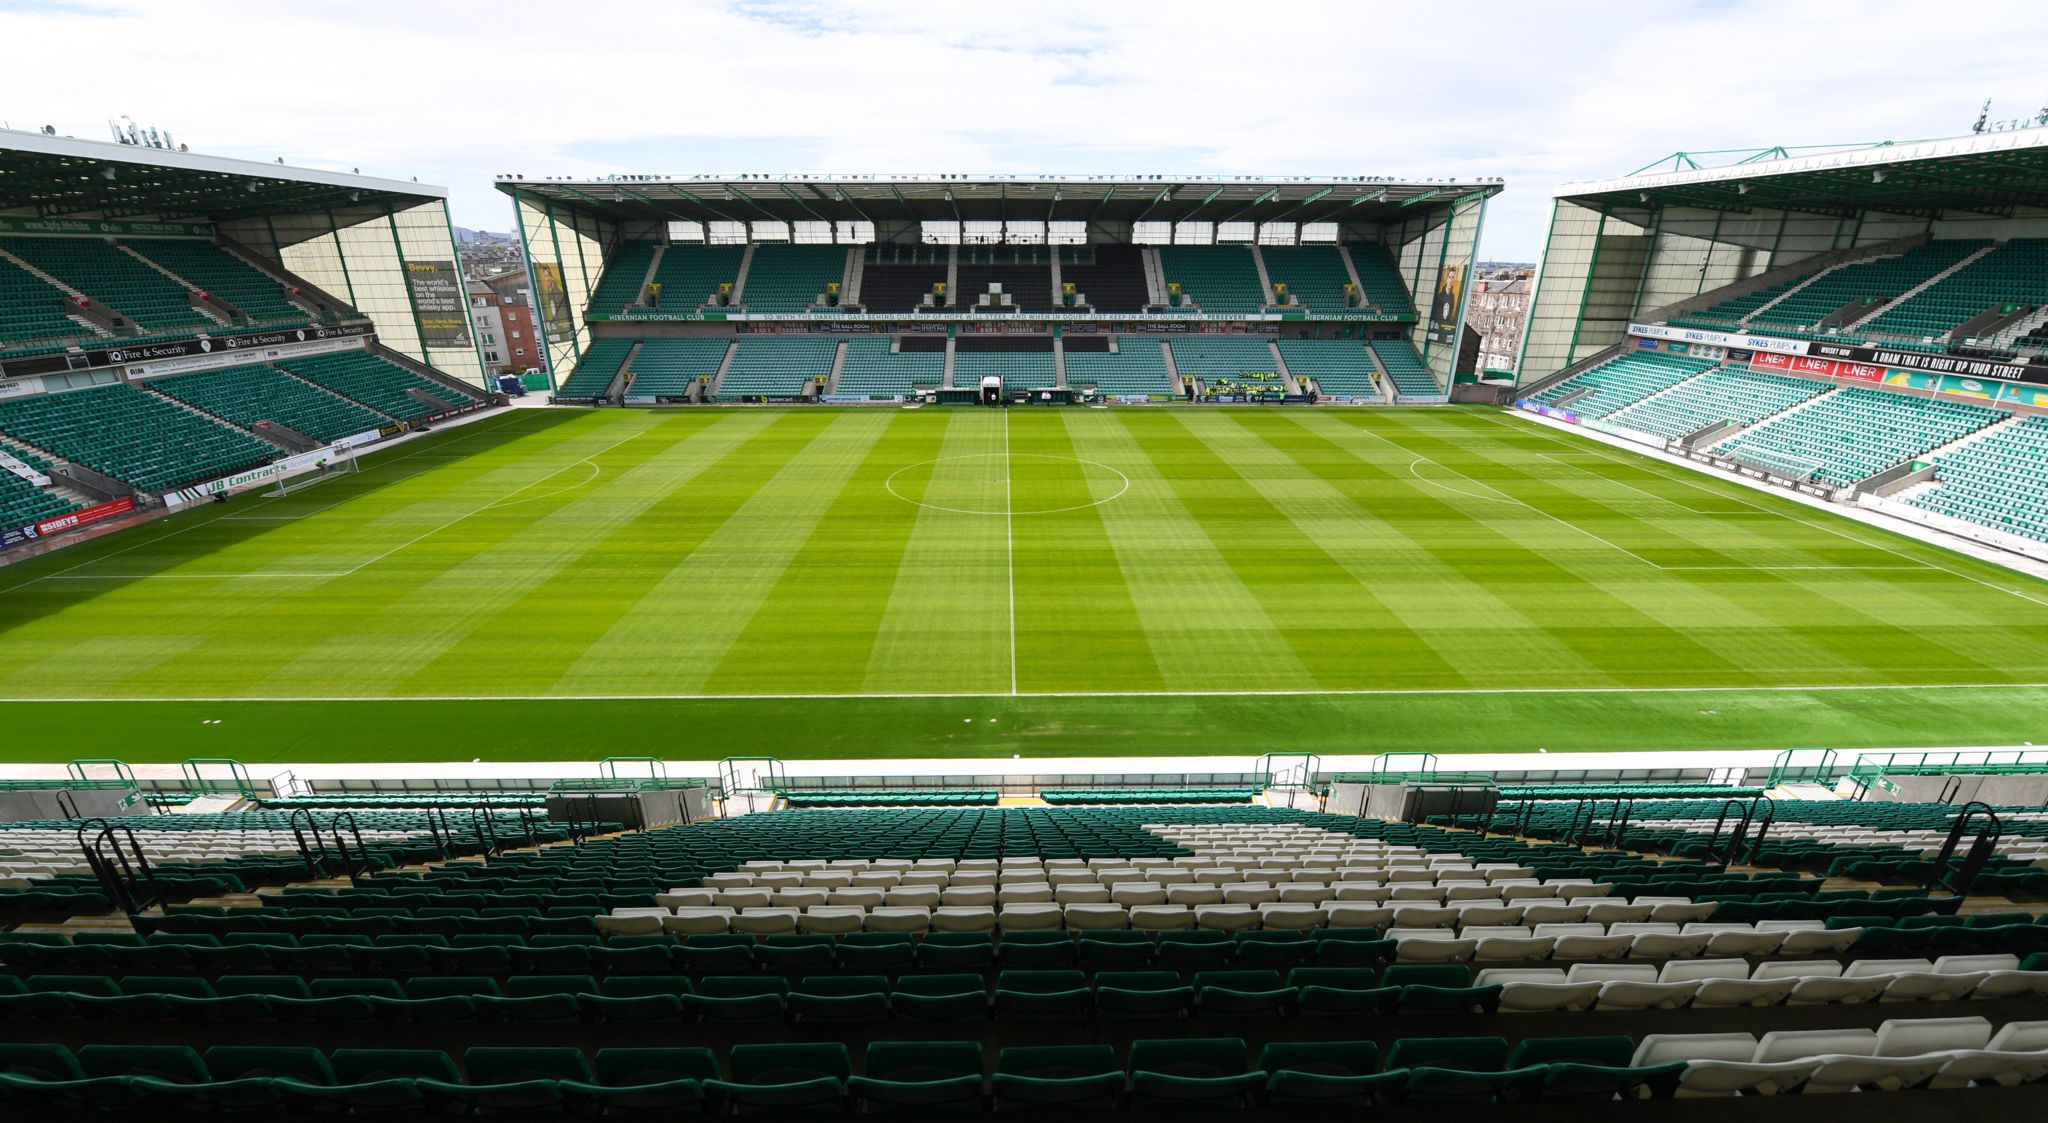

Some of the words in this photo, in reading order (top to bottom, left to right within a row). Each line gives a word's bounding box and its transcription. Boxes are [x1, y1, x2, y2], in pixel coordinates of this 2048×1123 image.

[608, 313, 648, 321] HIBERNIAN
[649, 313, 686, 321] FOOTBALL
[686, 313, 705, 321] CLUB
[325, 328, 337, 336] Fire
[342, 326, 364, 335] Security
[1632, 325, 1648, 334] SYKES
[1648, 328, 1664, 336] PUMPS
[237, 338, 251, 346] Fire
[258, 334, 286, 343] Security
[1685, 331, 1703, 340] SYKES
[1704, 334, 1722, 343] PUMPS
[1747, 338, 1769, 348] SYKES
[1769, 340, 1791, 350] PUMPS
[123, 350, 141, 360] Fire
[143, 349, 151, 357] &
[151, 345, 186, 356] Security
[1820, 346, 1840, 355] WHISKY
[1839, 348, 1852, 357] ROW
[1760, 353, 1786, 365] LNER
[1800, 358, 1829, 370] LNER
[1872, 351, 1879, 361] A
[1879, 352, 1901, 365] DRAM
[1901, 354, 1921, 367] THAT
[1921, 356, 1930, 369] IS
[1930, 357, 1956, 371] RIGHT
[1955, 360, 1969, 373] UP
[1969, 362, 1992, 376] YOUR
[1992, 364, 2025, 379] STREET
[1844, 364, 1877, 378] LNER
[208, 480, 225, 494] JB
[229, 464, 287, 487] Contracts
